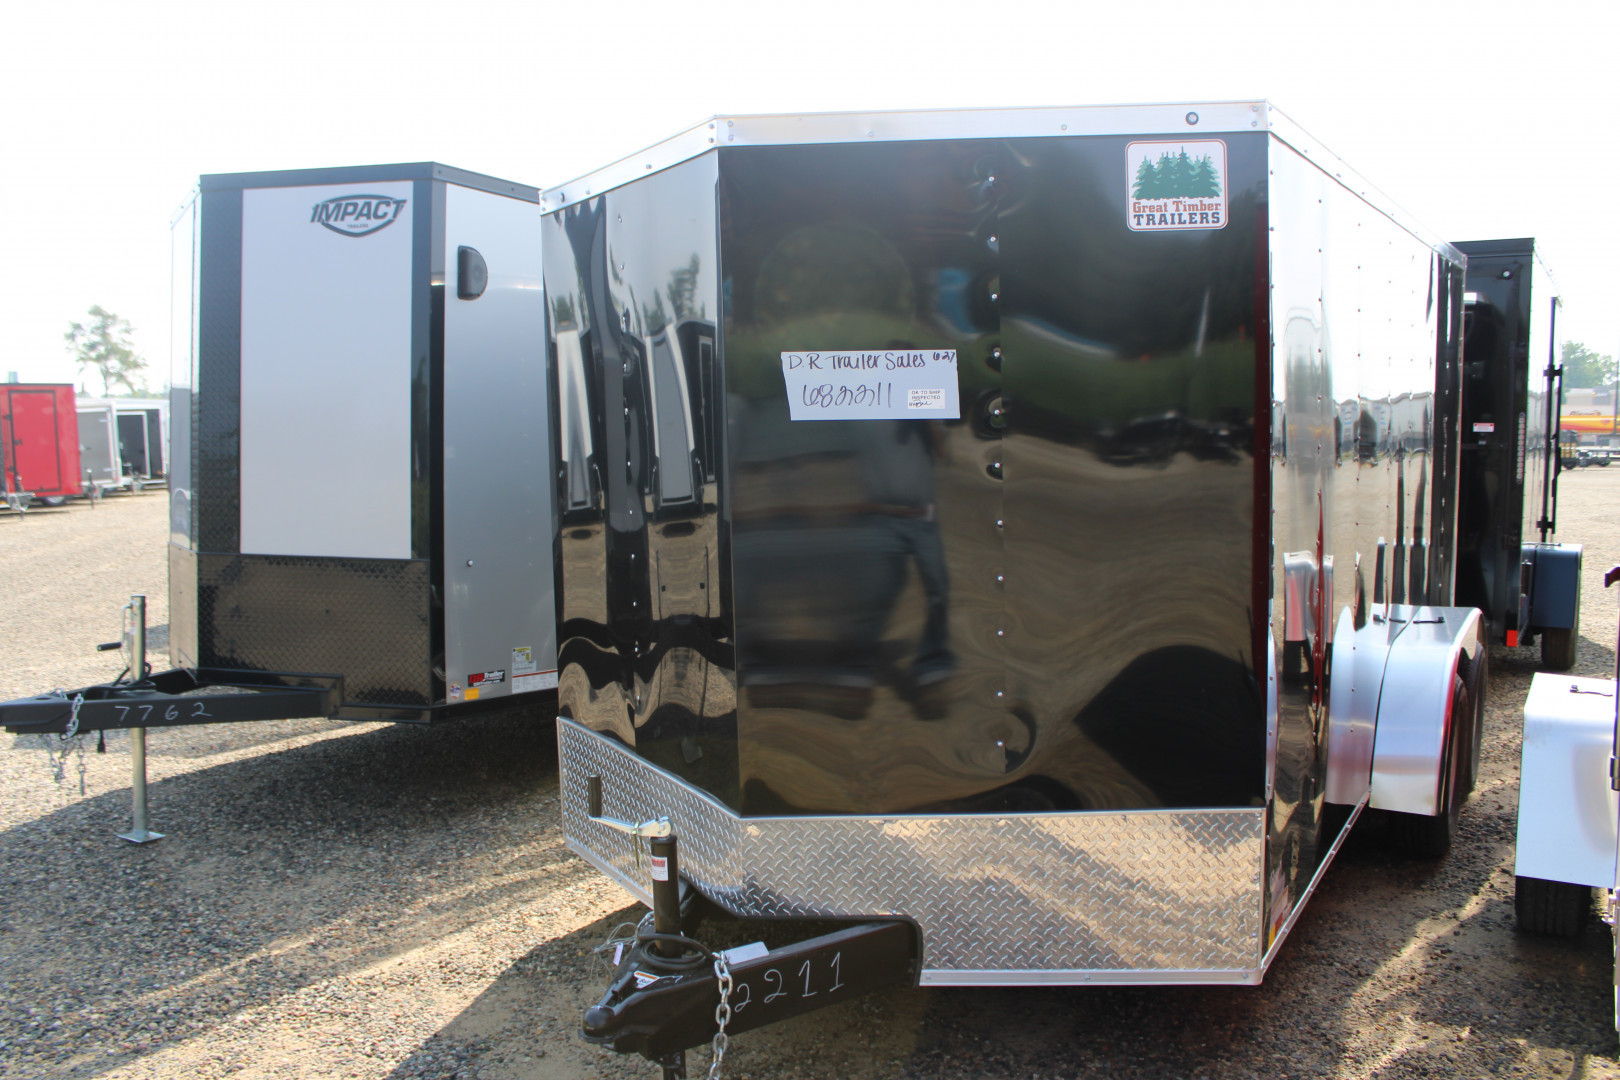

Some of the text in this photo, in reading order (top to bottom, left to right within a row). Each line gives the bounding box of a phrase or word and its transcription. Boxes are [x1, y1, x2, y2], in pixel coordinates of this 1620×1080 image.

[310, 199, 407, 223] IMPACT
[1132, 200, 1221, 213] Great Timber
[1133, 212, 1220, 226] TRAILERS
[885, 352, 926, 370] Sales
[114, 702, 213, 721] 7762
[734, 952, 845, 1012] 2211
